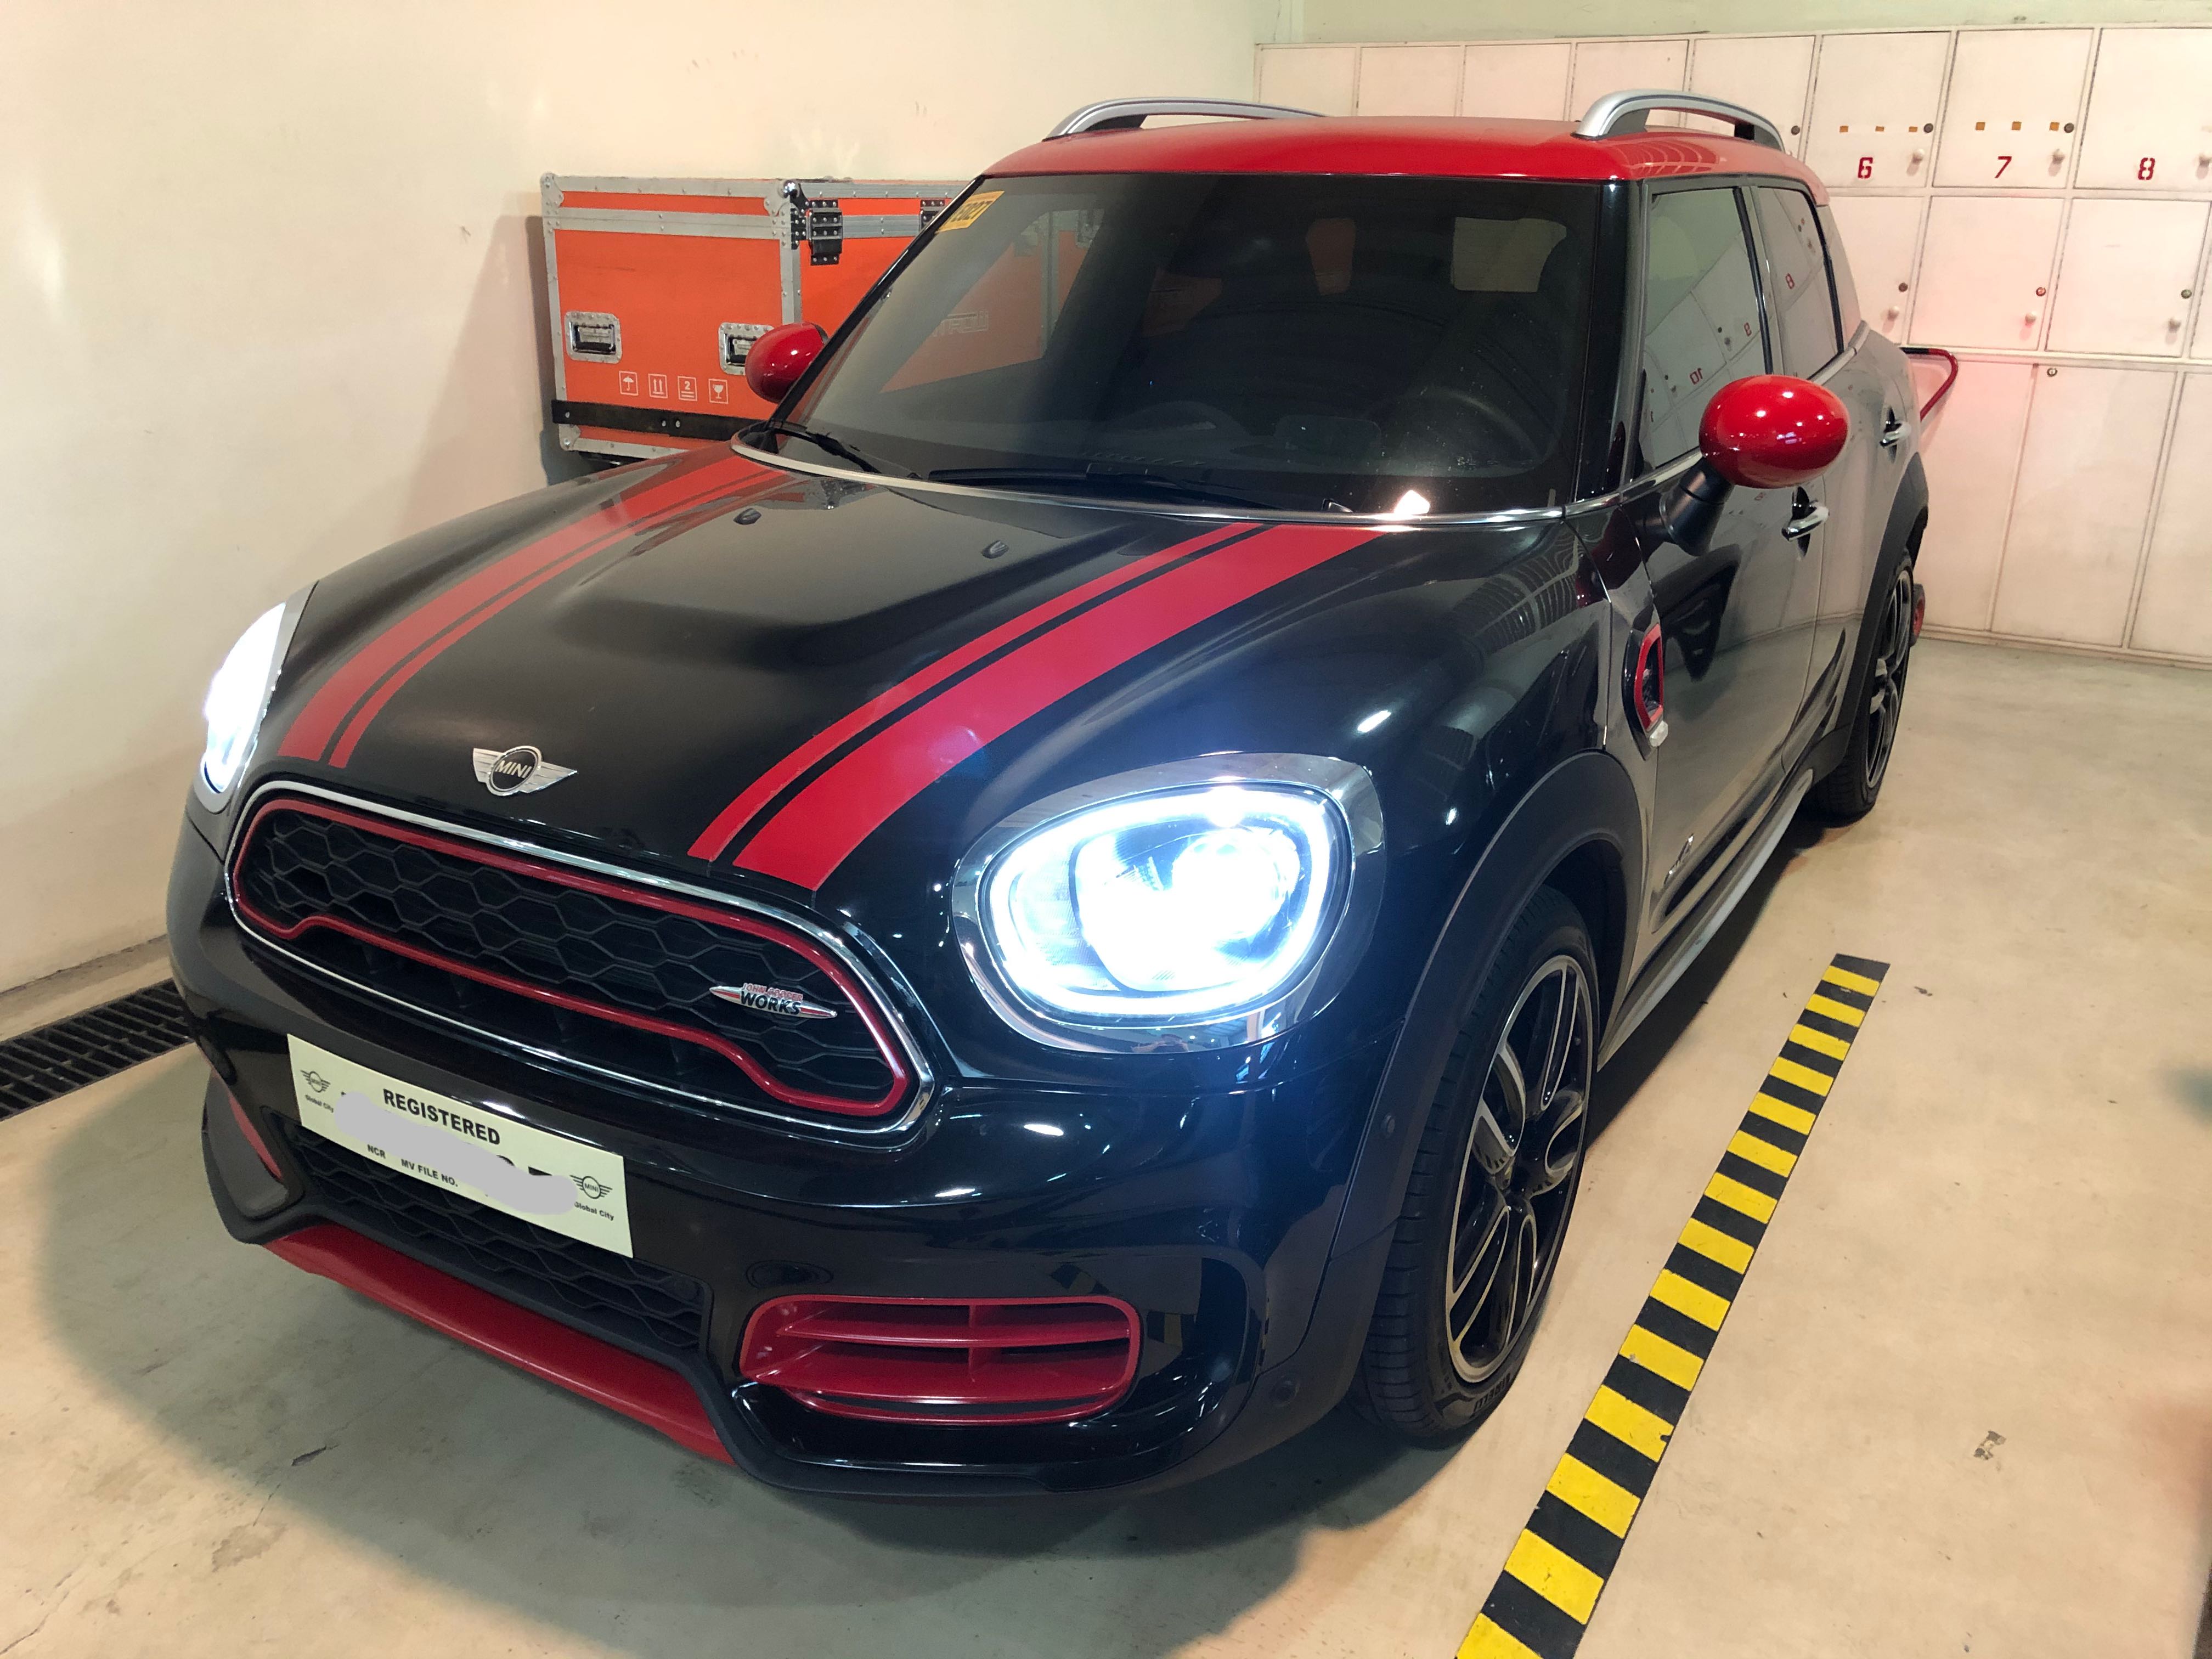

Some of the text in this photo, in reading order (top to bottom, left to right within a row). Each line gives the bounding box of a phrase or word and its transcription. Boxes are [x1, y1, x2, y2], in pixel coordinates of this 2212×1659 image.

[1857, 156, 1874, 179] 6
[1994, 155, 2012, 179] 7
[2137, 157, 2156, 180] 8
[684, 380, 691, 391] 2
[495, 760, 533, 778] MINI
[742, 983, 768, 994] JOHN
[741, 991, 802, 1015] WORKS
[382, 1088, 501, 1146] REGISTERED
[367, 1144, 459, 1187] NCR MV FILE NO.
[584, 1183, 599, 1193] MINI
[574, 1201, 614, 1221] Global City
